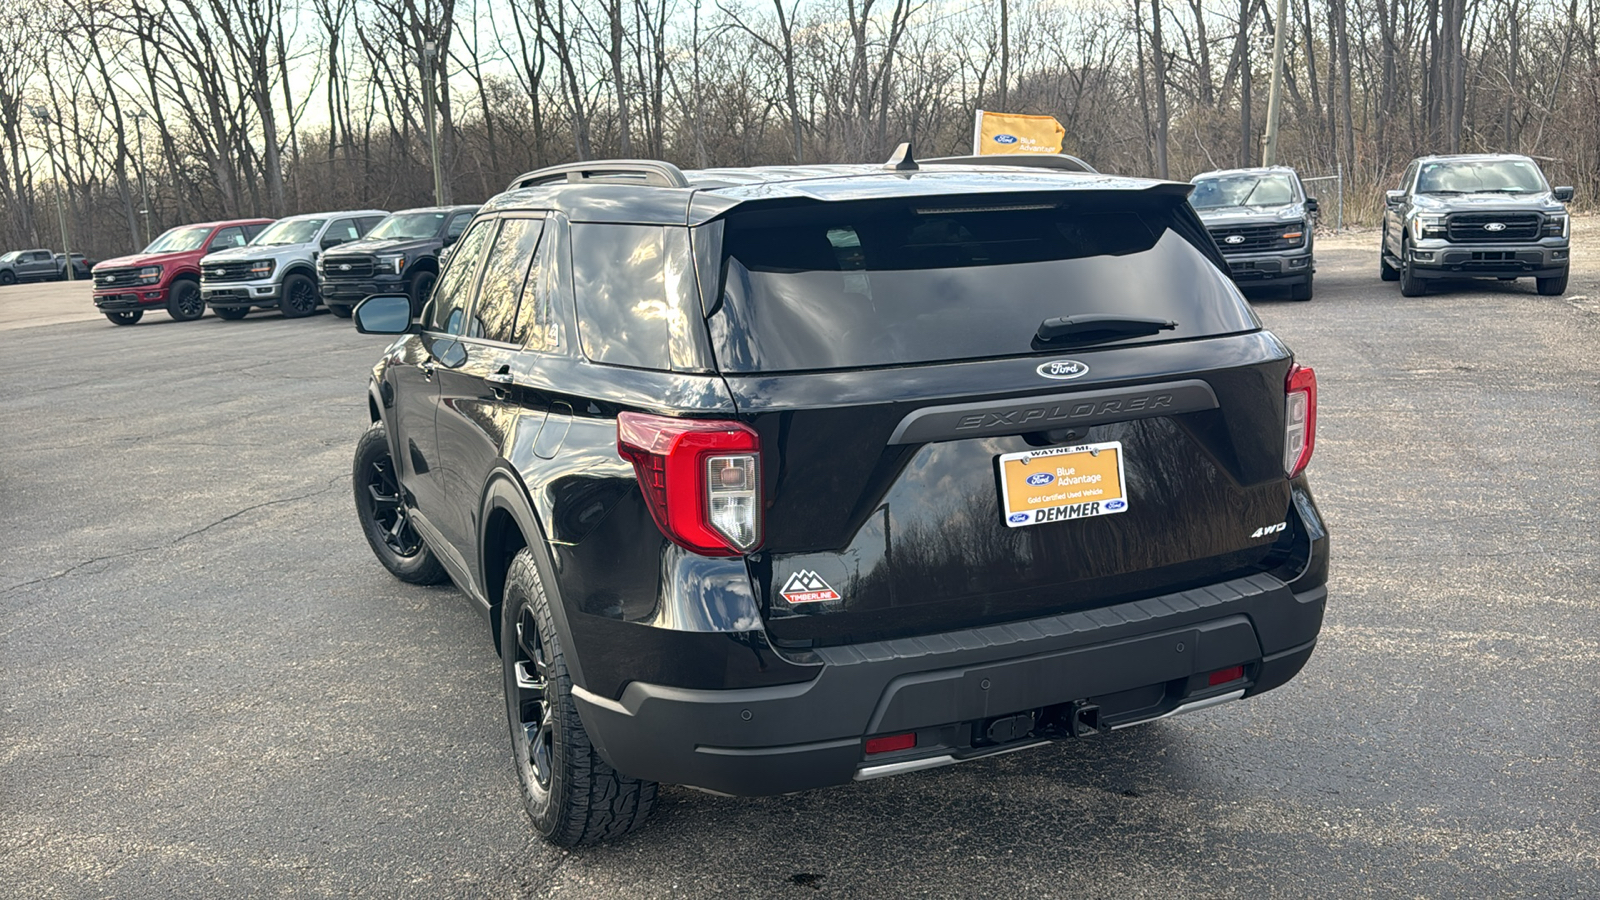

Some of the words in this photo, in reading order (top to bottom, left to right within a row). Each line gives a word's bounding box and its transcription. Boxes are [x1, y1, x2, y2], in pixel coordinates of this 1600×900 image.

[1020, 137, 1036, 145] Blue
[1019, 144, 1056, 152] Advantage
[955, 394, 1173, 430] EXPLORER
[1056, 467, 1075, 476] Blue
[1057, 474, 1102, 486] Advantage
[1027, 496, 1042, 504] Gold
[1042, 492, 1066, 502] Certified
[1066, 490, 1082, 499] Used
[1082, 487, 1104, 497] Vehicle
[1034, 501, 1100, 523] DEMMER
[1250, 521, 1287, 538] 4WD
[790, 592, 832, 601] TIMBERLINE
